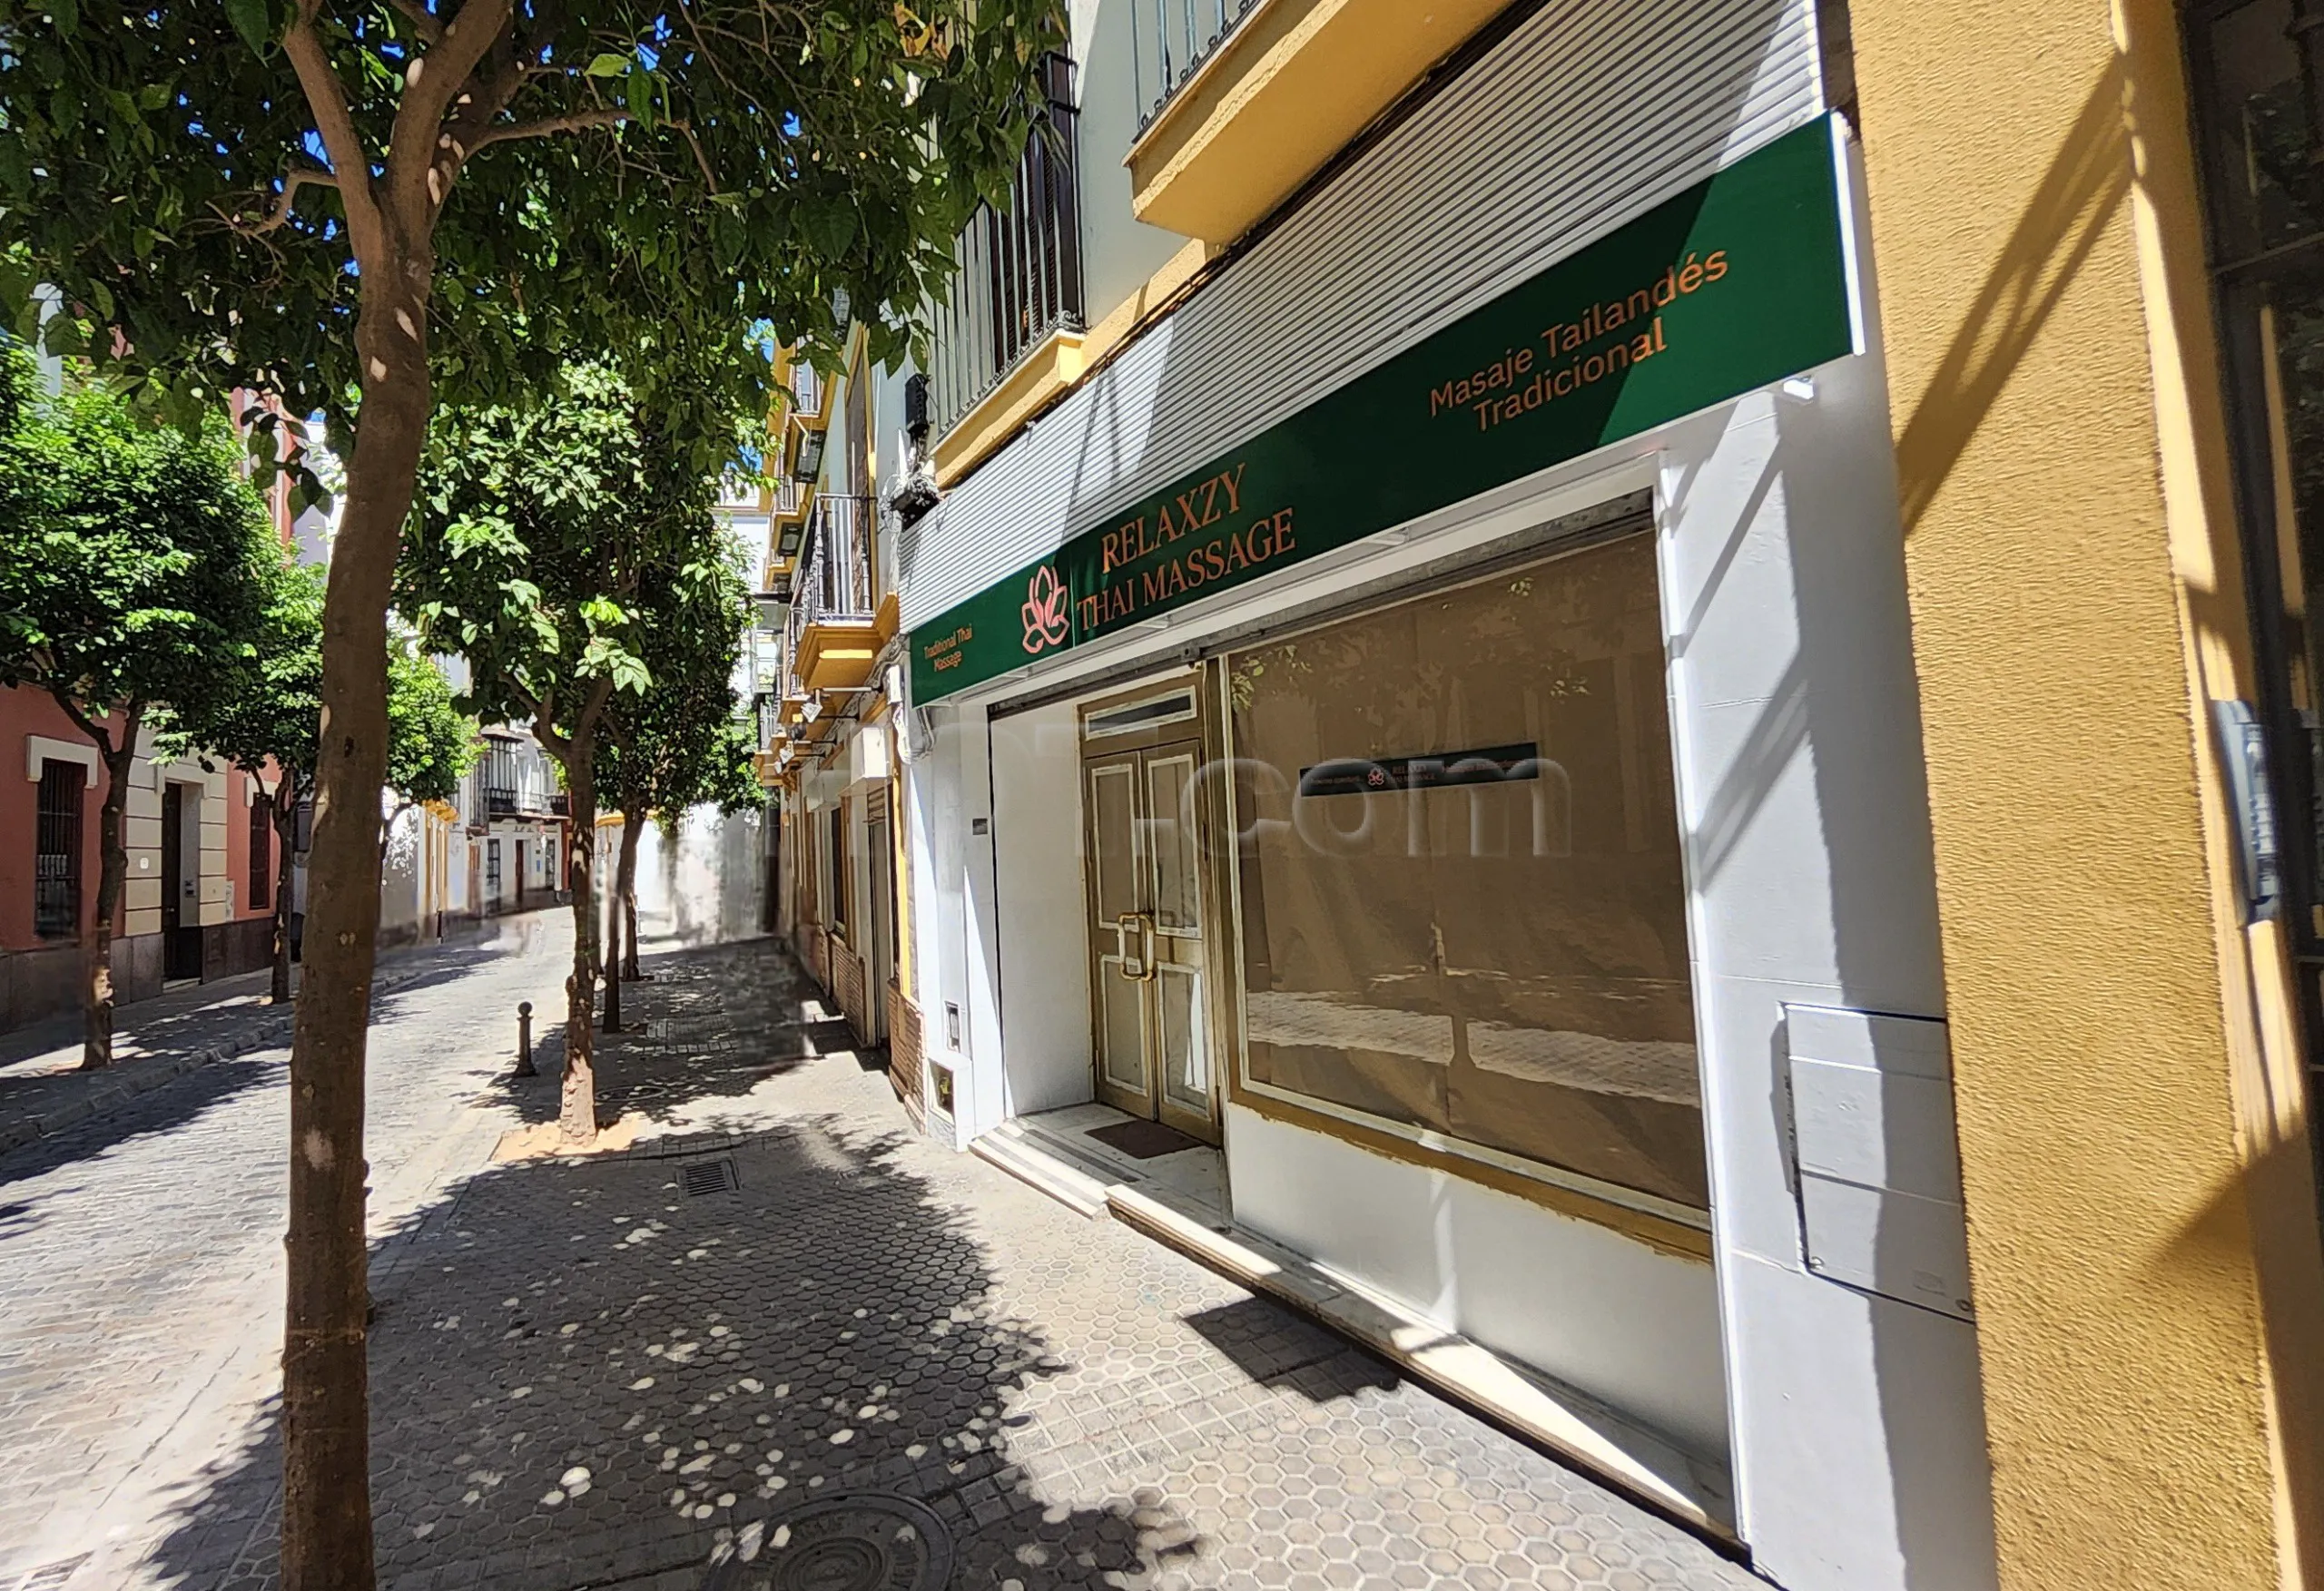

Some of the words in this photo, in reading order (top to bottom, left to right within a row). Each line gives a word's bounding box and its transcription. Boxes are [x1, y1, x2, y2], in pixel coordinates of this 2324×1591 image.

[1429, 347, 1534, 419] Masaje
[1540, 249, 1729, 359] Tailandés
[1472, 316, 1668, 433] Tradicional
[1076, 582, 1136, 632] THAI
[1142, 507, 1296, 611] MASSAGE
[1100, 462, 1246, 575] RELAXZY
